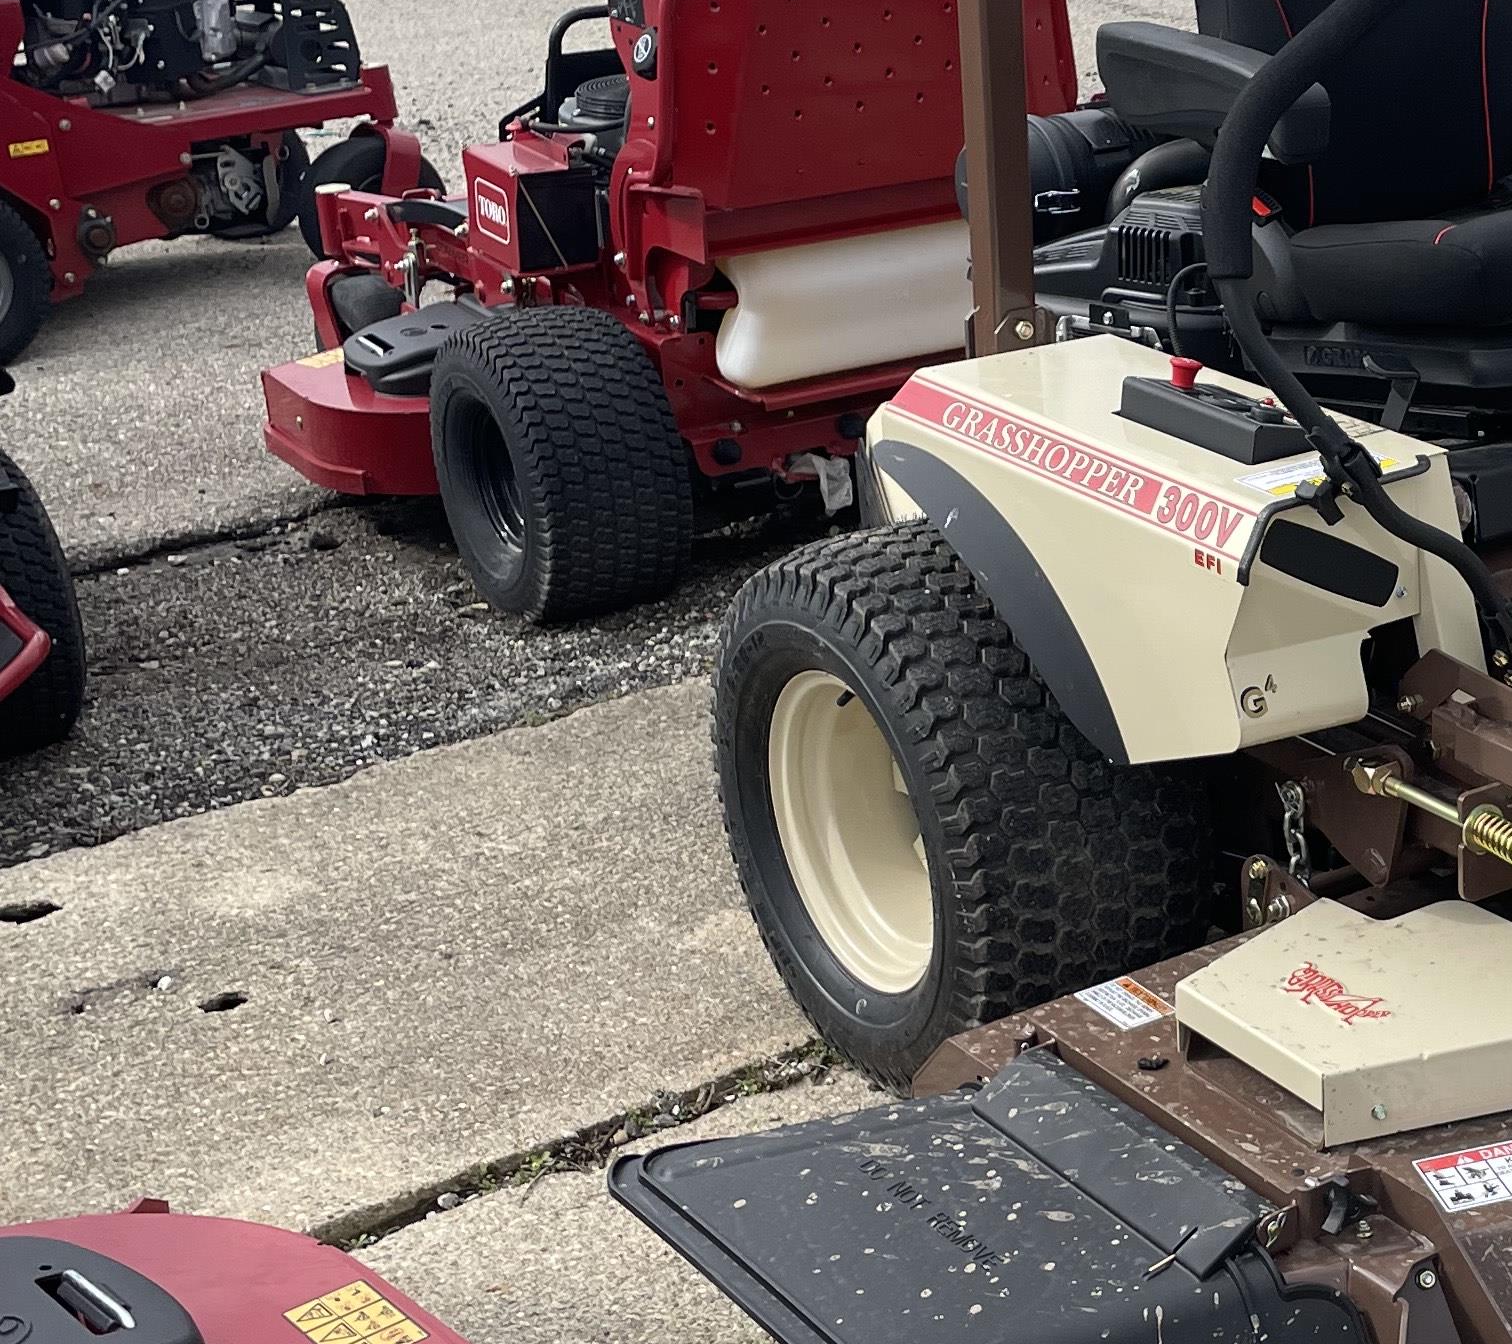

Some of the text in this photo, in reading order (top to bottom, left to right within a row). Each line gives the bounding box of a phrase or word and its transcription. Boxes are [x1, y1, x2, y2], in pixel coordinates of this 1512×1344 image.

[478, 195, 506, 226] TORO
[942, 402, 1145, 506] GRASSHOPPER
[1156, 486, 1244, 549] 300V
[1194, 549, 1222, 575] EFI
[858, 1159, 1005, 1272] DO NOT REMOVE
